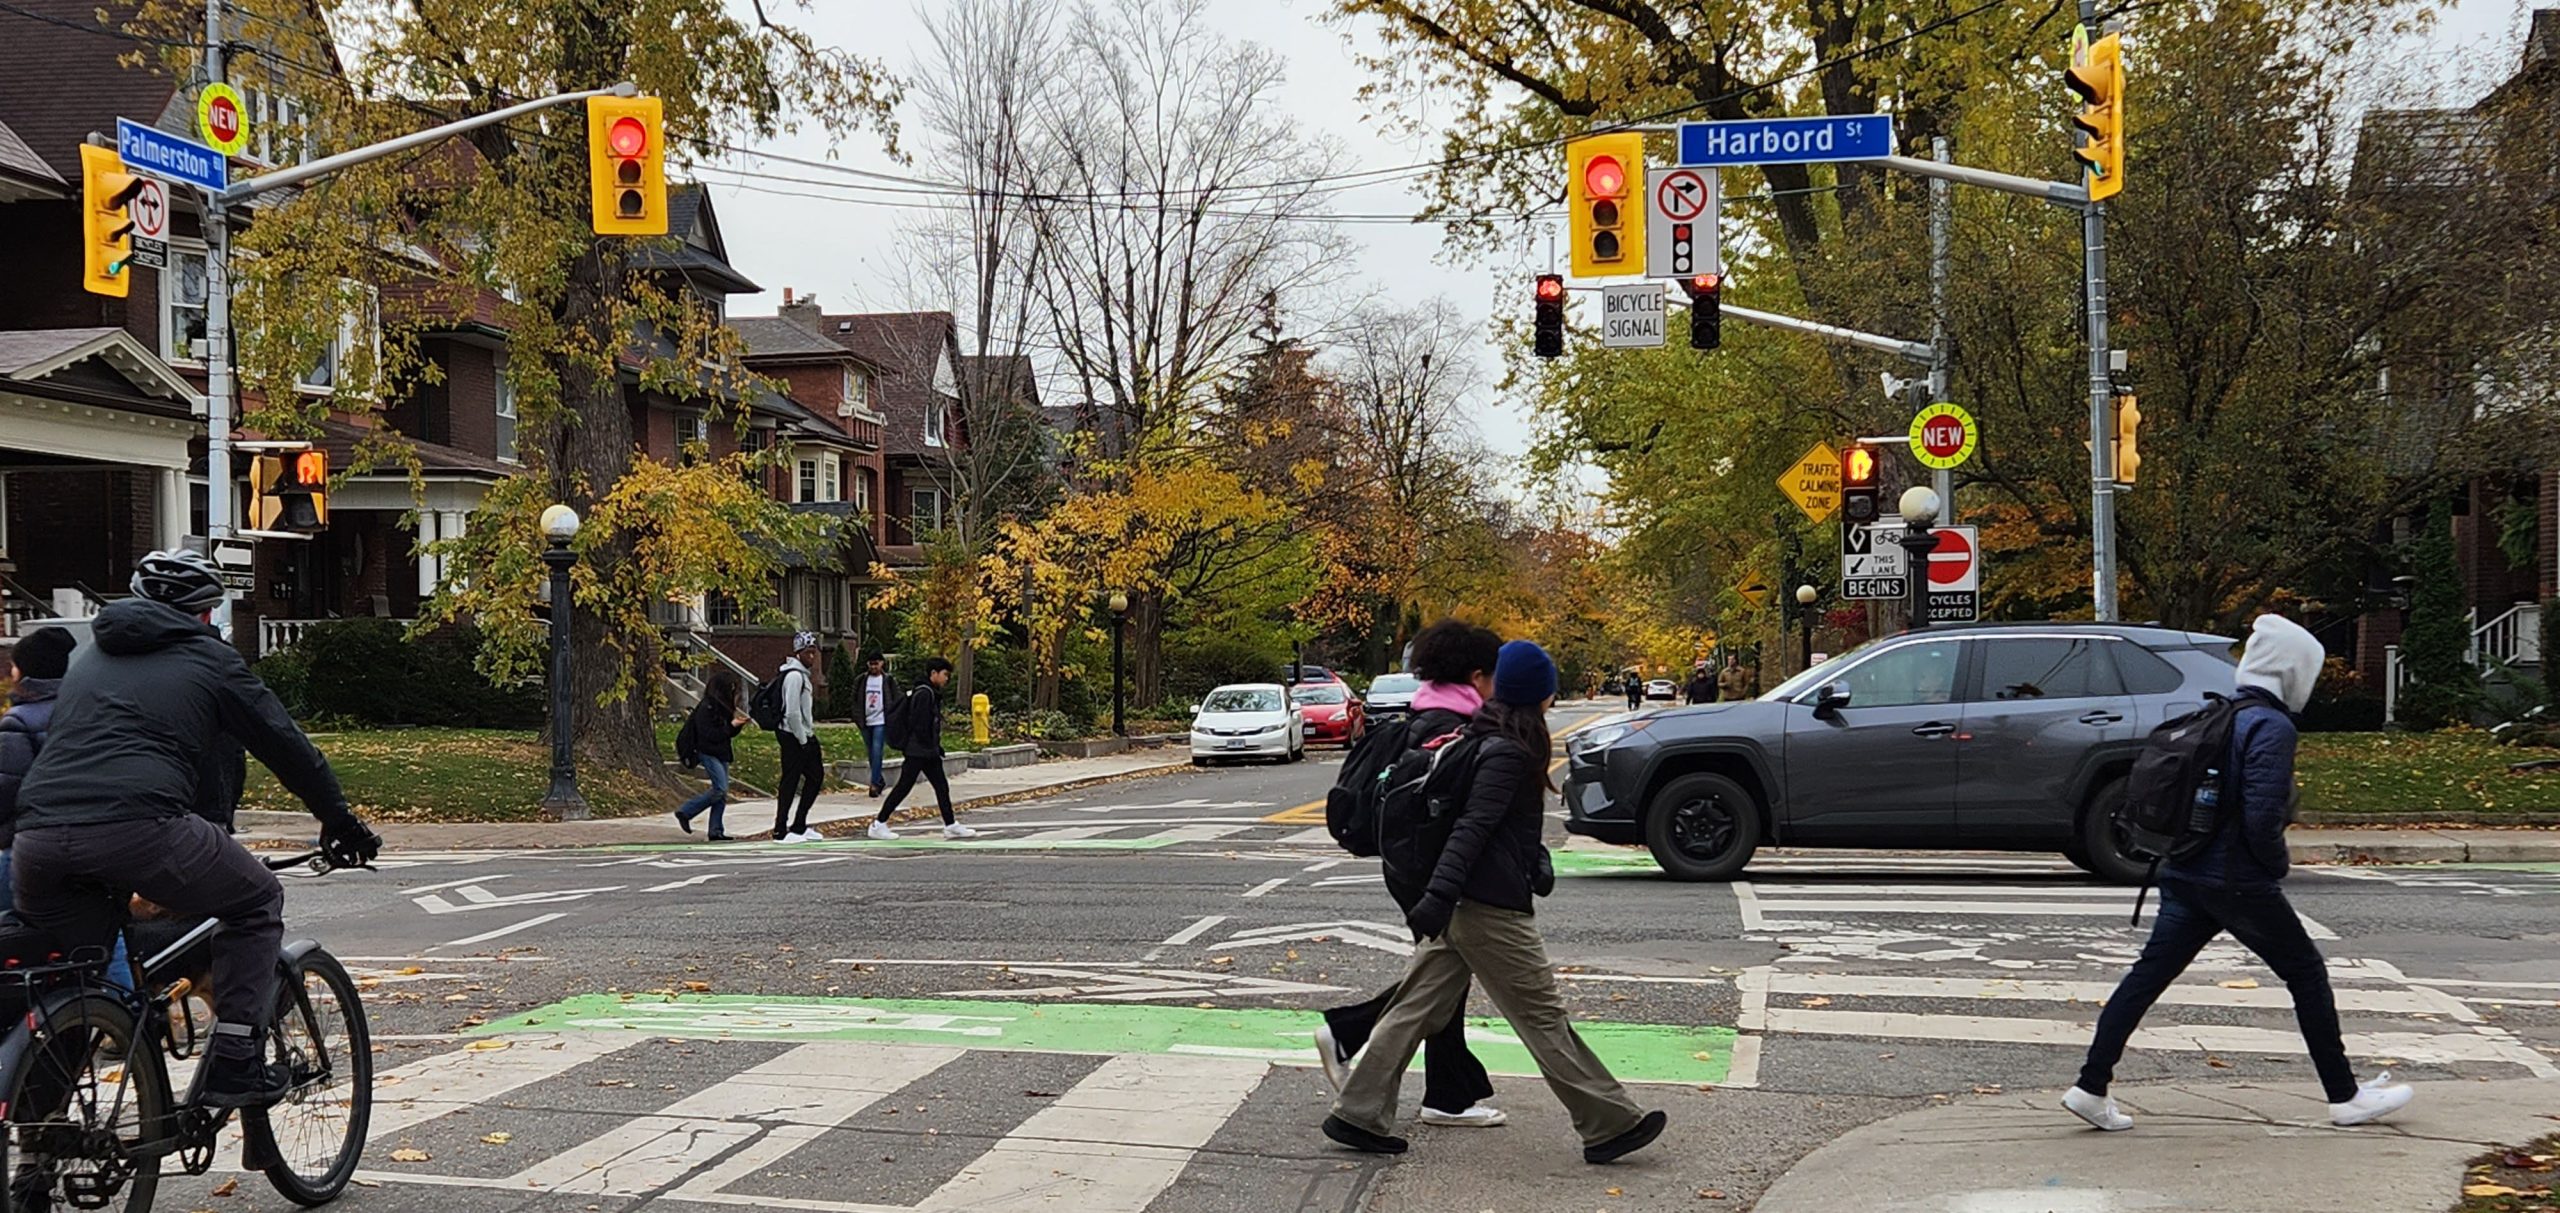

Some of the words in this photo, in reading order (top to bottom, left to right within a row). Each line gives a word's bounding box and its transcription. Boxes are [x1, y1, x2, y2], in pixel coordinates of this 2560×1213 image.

[208, 105, 238, 131] NEW
[1707, 123, 1834, 155] Harbord
[1846, 121, 1862, 137] St
[120, 124, 209, 179] Palmerston
[1607, 292, 1662, 314] BICYCLE
[1609, 318, 1660, 338] SIGNAL
[1923, 426, 1962, 447] NEW
[1803, 463, 1840, 477] TRAFFIC
[1799, 479, 1840, 493] CALMING
[1805, 496, 1831, 509] ZONE
[1874, 555, 1895, 564] THIS
[1871, 565, 1896, 575] LANE
[1848, 580, 1900, 596] BEGINS
[1929, 594, 1972, 606] CYCLES
[1928, 608, 1974, 619] CEPTED
